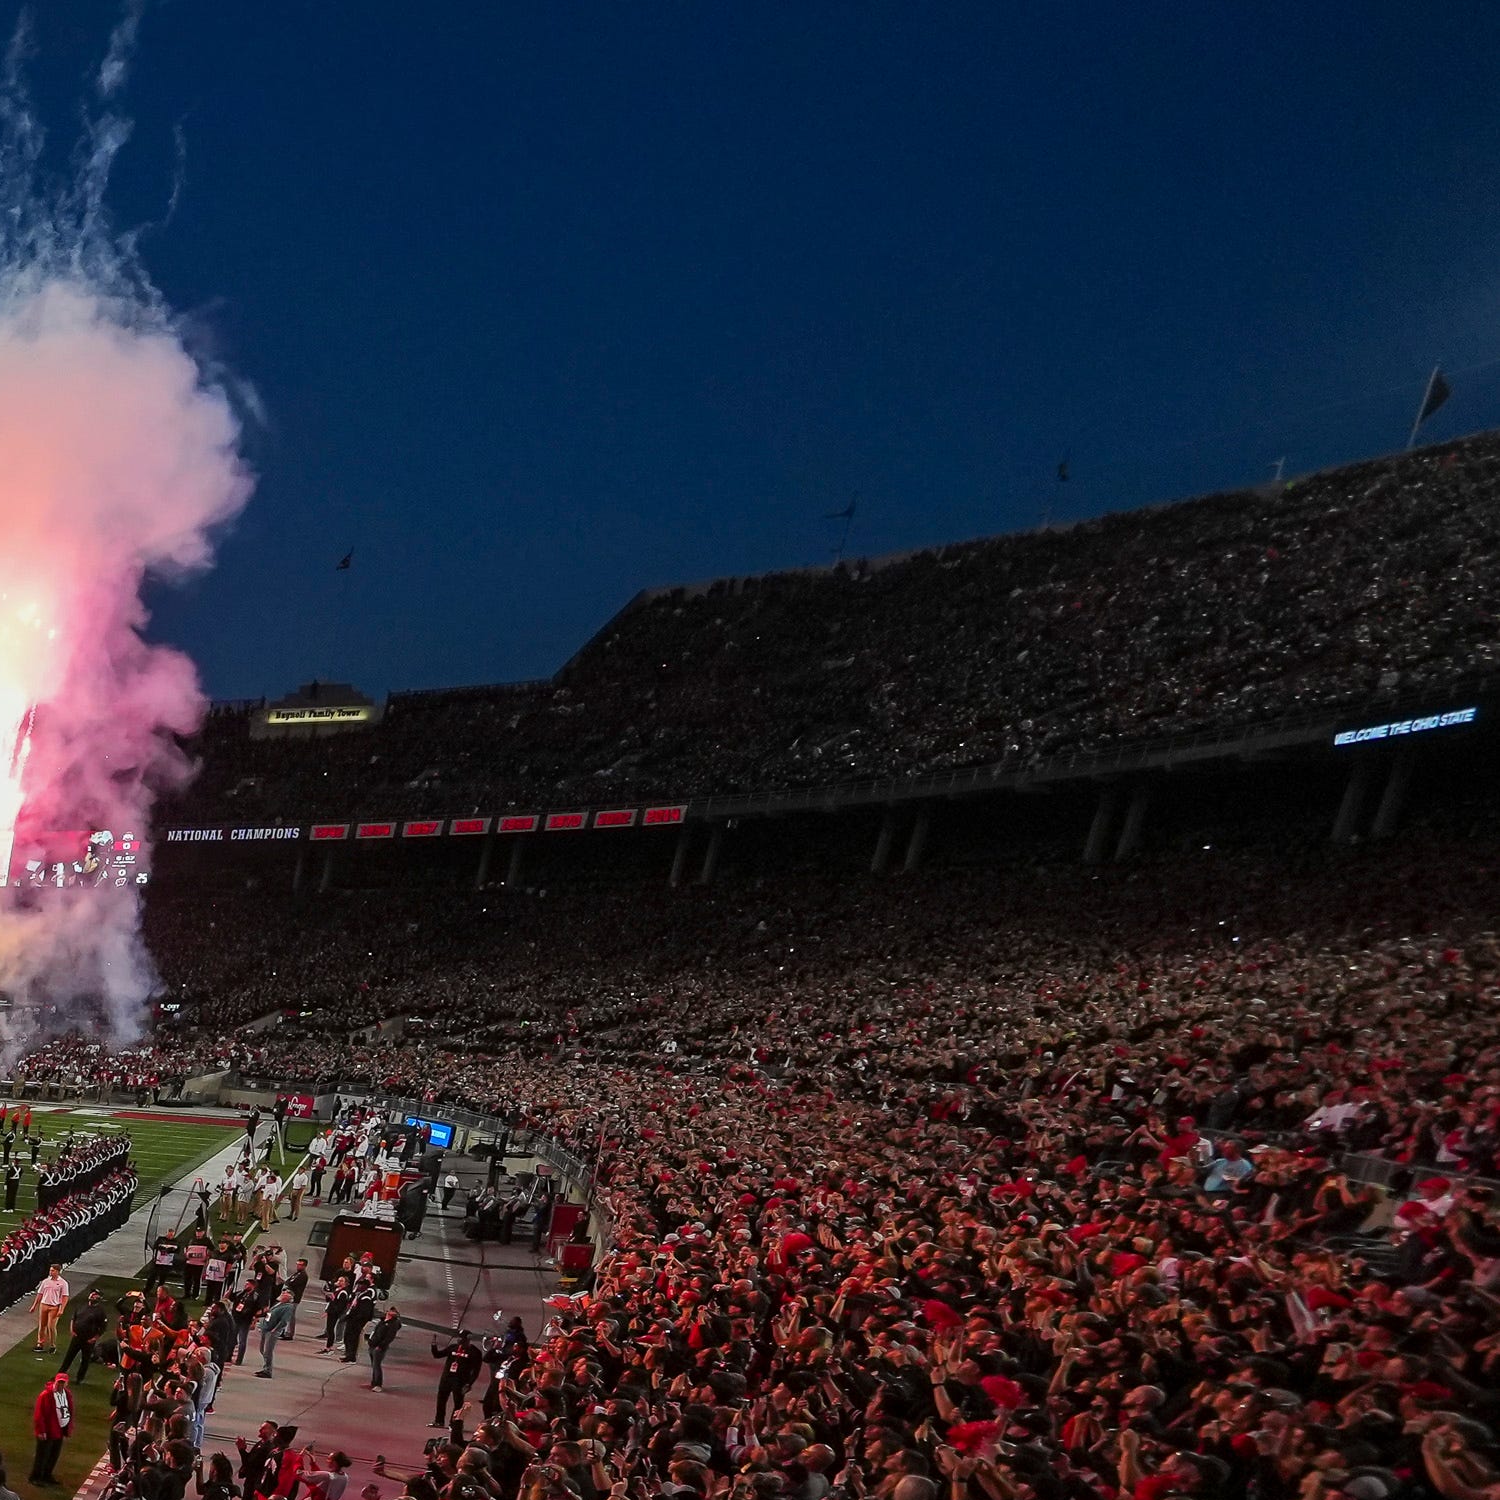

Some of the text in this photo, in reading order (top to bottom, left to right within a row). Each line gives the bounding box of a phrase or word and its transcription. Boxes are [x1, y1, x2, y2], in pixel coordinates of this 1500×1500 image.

[1334, 707, 1476, 745] WELCOME THE OHIO STATE
[168, 827, 300, 841] NATIONAL CHAMPIONS
